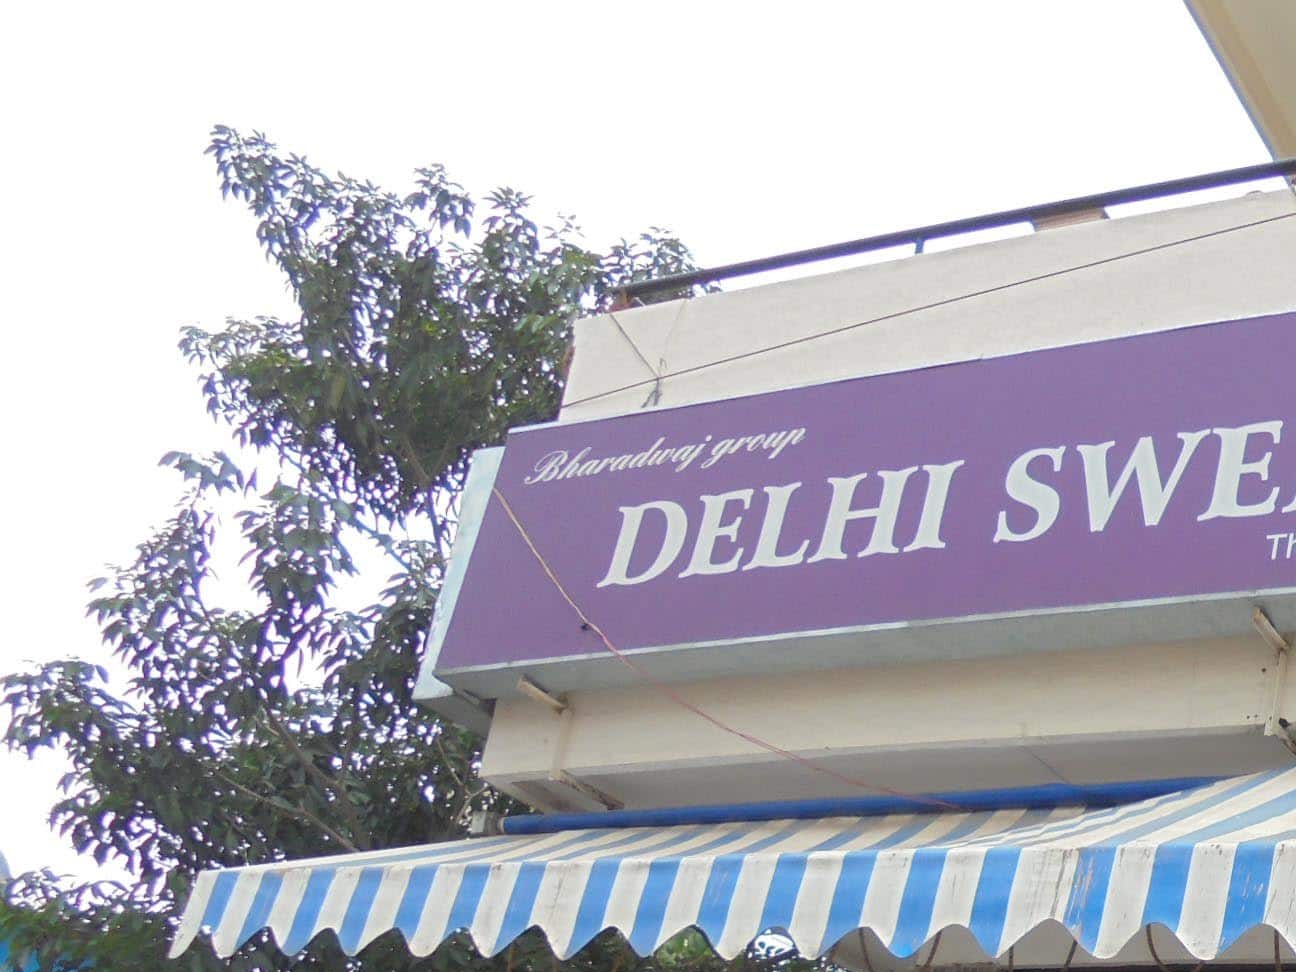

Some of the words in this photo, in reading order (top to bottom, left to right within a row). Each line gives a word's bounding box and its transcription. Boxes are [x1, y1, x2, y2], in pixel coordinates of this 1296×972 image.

[524, 434, 712, 484] Bharadwaj
[701, 427, 807, 469] group
[596, 459, 965, 588] DELHI
